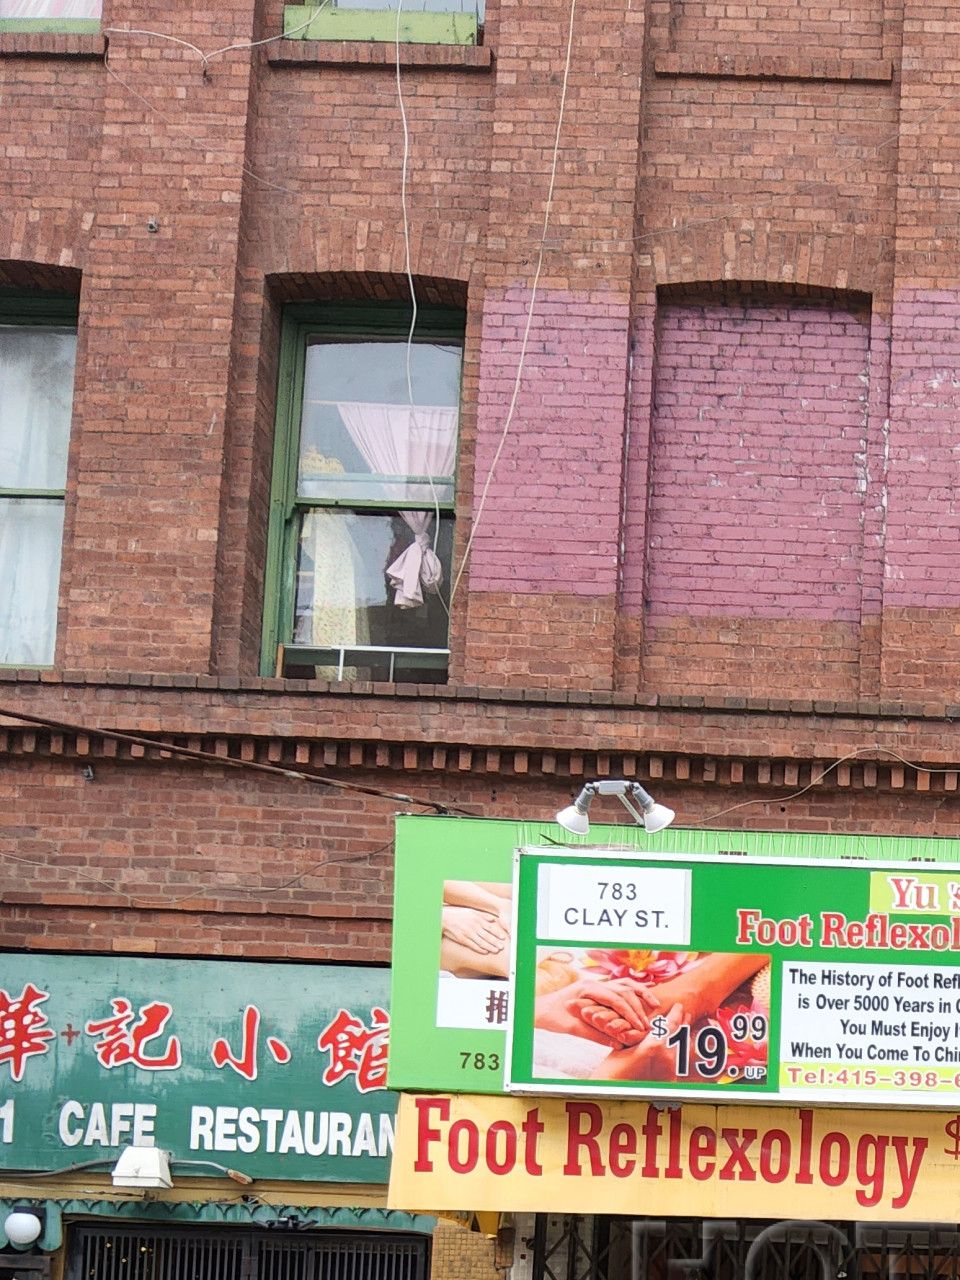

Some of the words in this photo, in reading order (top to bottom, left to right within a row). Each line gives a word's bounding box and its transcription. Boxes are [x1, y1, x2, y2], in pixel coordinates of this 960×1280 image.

[597, 882, 637, 900] 783
[563, 907, 628, 928] CLAY
[634, 909, 669, 929] ST.
[737, 909, 812, 946] Foot
[789, 968, 816, 984] The
[821, 969, 874, 990] History
[878, 972, 892, 987] of
[897, 972, 929, 988] Foot
[798, 993, 810, 1009] is
[816, 994, 849, 1011] Over
[854, 995, 889, 1011] 5000
[894, 997, 934, 1013] Years
[939, 998, 951, 1013] in
[840, 1019, 866, 1035] You
[871, 1020, 906, 1036] Must
[911, 1022, 950, 1041] Enjoy
[460, 1051, 500, 1071] 783
[791, 1042, 831, 1058] When
[836, 1043, 863, 1059] You
[867, 1044, 908, 1061] Come
[913, 1046, 930, 1062] To
[744, 1067, 767, 1079] UP
[59, 1100, 157, 1148] CAFE
[414, 1097, 544, 1176] Foot
[563, 1100, 929, 1210] Reflexology
